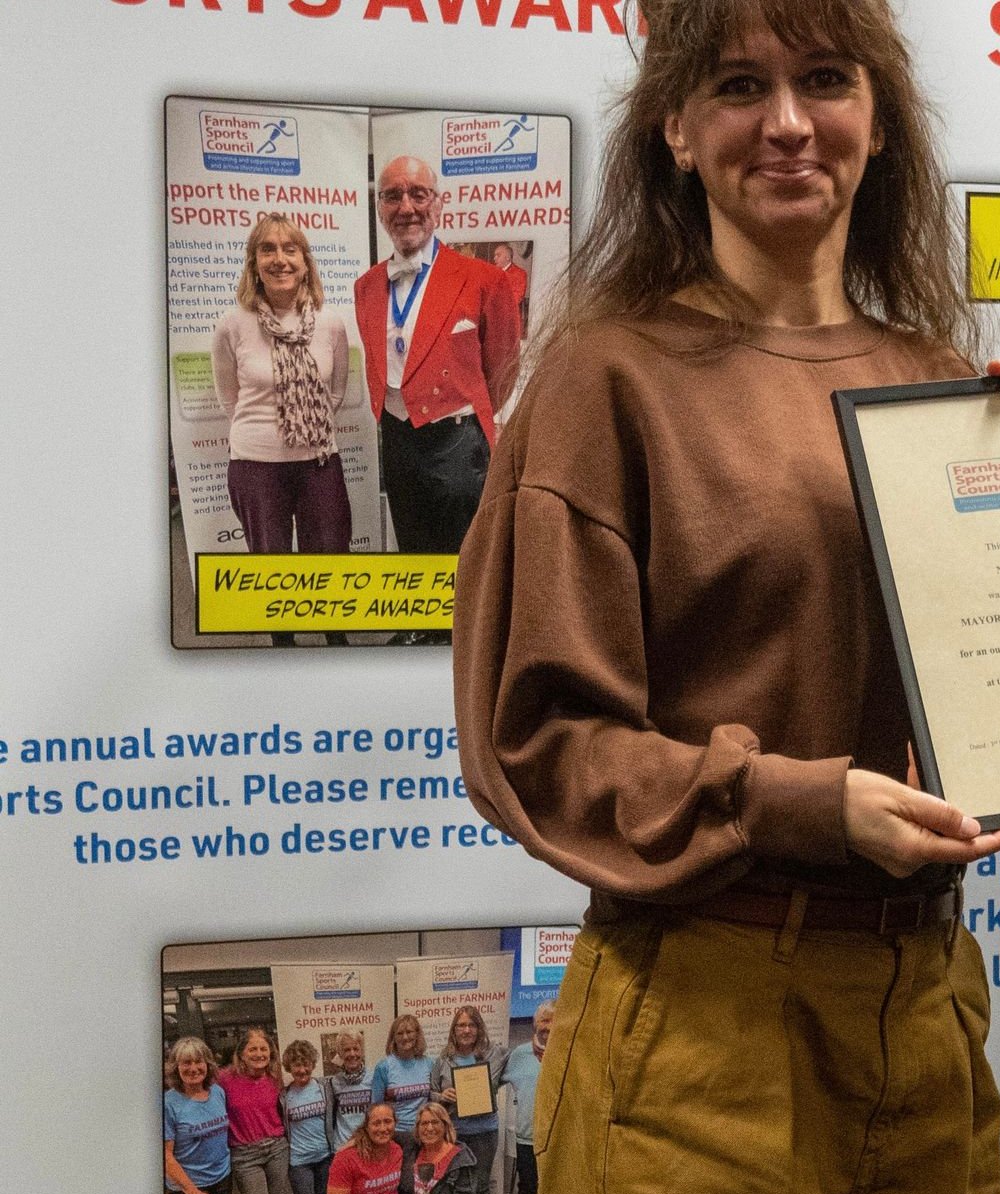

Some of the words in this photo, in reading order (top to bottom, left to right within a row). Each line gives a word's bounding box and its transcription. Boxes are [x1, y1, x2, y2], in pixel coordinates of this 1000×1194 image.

[204, 115, 260, 130] Farnham
[446, 119, 500, 133] Farnham
[206, 127, 248, 141] Sports
[446, 132, 487, 146] Sports
[206, 140, 254, 154] Council
[446, 142, 492, 156] Council
[229, 183, 260, 201] the
[265, 185, 357, 207] FARNHAM
[458, 179, 562, 203] FARNHAM
[171, 207, 251, 227] SPORTS
[434, 211, 479, 230] RTS
[215, 241, 224, 249] in
[170, 269, 201, 278] Active
[328, 271, 359, 279] Council
[180, 283, 226, 292] Farnham
[192, 439, 217, 448] WITH
[188, 463, 198, 471] To
[200, 462, 212, 470] be
[189, 473, 213, 483] sport
[192, 494, 229, 504] working
[194, 506, 210, 515] and
[342, 572, 371, 590] TO
[381, 572, 424, 590] THE
[265, 598, 358, 618] SPORTS
[365, 598, 455, 617] AWARDS
[959, 649, 974, 659] for
[976, 648, 987, 656] an
[986, 679, 995, 687] at
[20, 727, 156, 763] annual
[164, 723, 303, 758] awards
[313, 728, 373, 753] are
[0, 785, 63, 816] rts
[75, 776, 231, 813] Council.
[243, 773, 369, 806] Please
[74, 832, 181, 864] those
[191, 825, 270, 858] who
[281, 822, 431, 855] deserve
[403, 996, 440, 1009] Support
[443, 996, 458, 1005] the
[459, 992, 506, 1003] FARNHAM
[303, 1005, 321, 1015] The
[325, 1002, 374, 1013] FARNHAM
[415, 1007, 452, 1019] SPORTS
[295, 1017, 337, 1029] SPORTS
[340, 1014, 381, 1026] AWARDS
